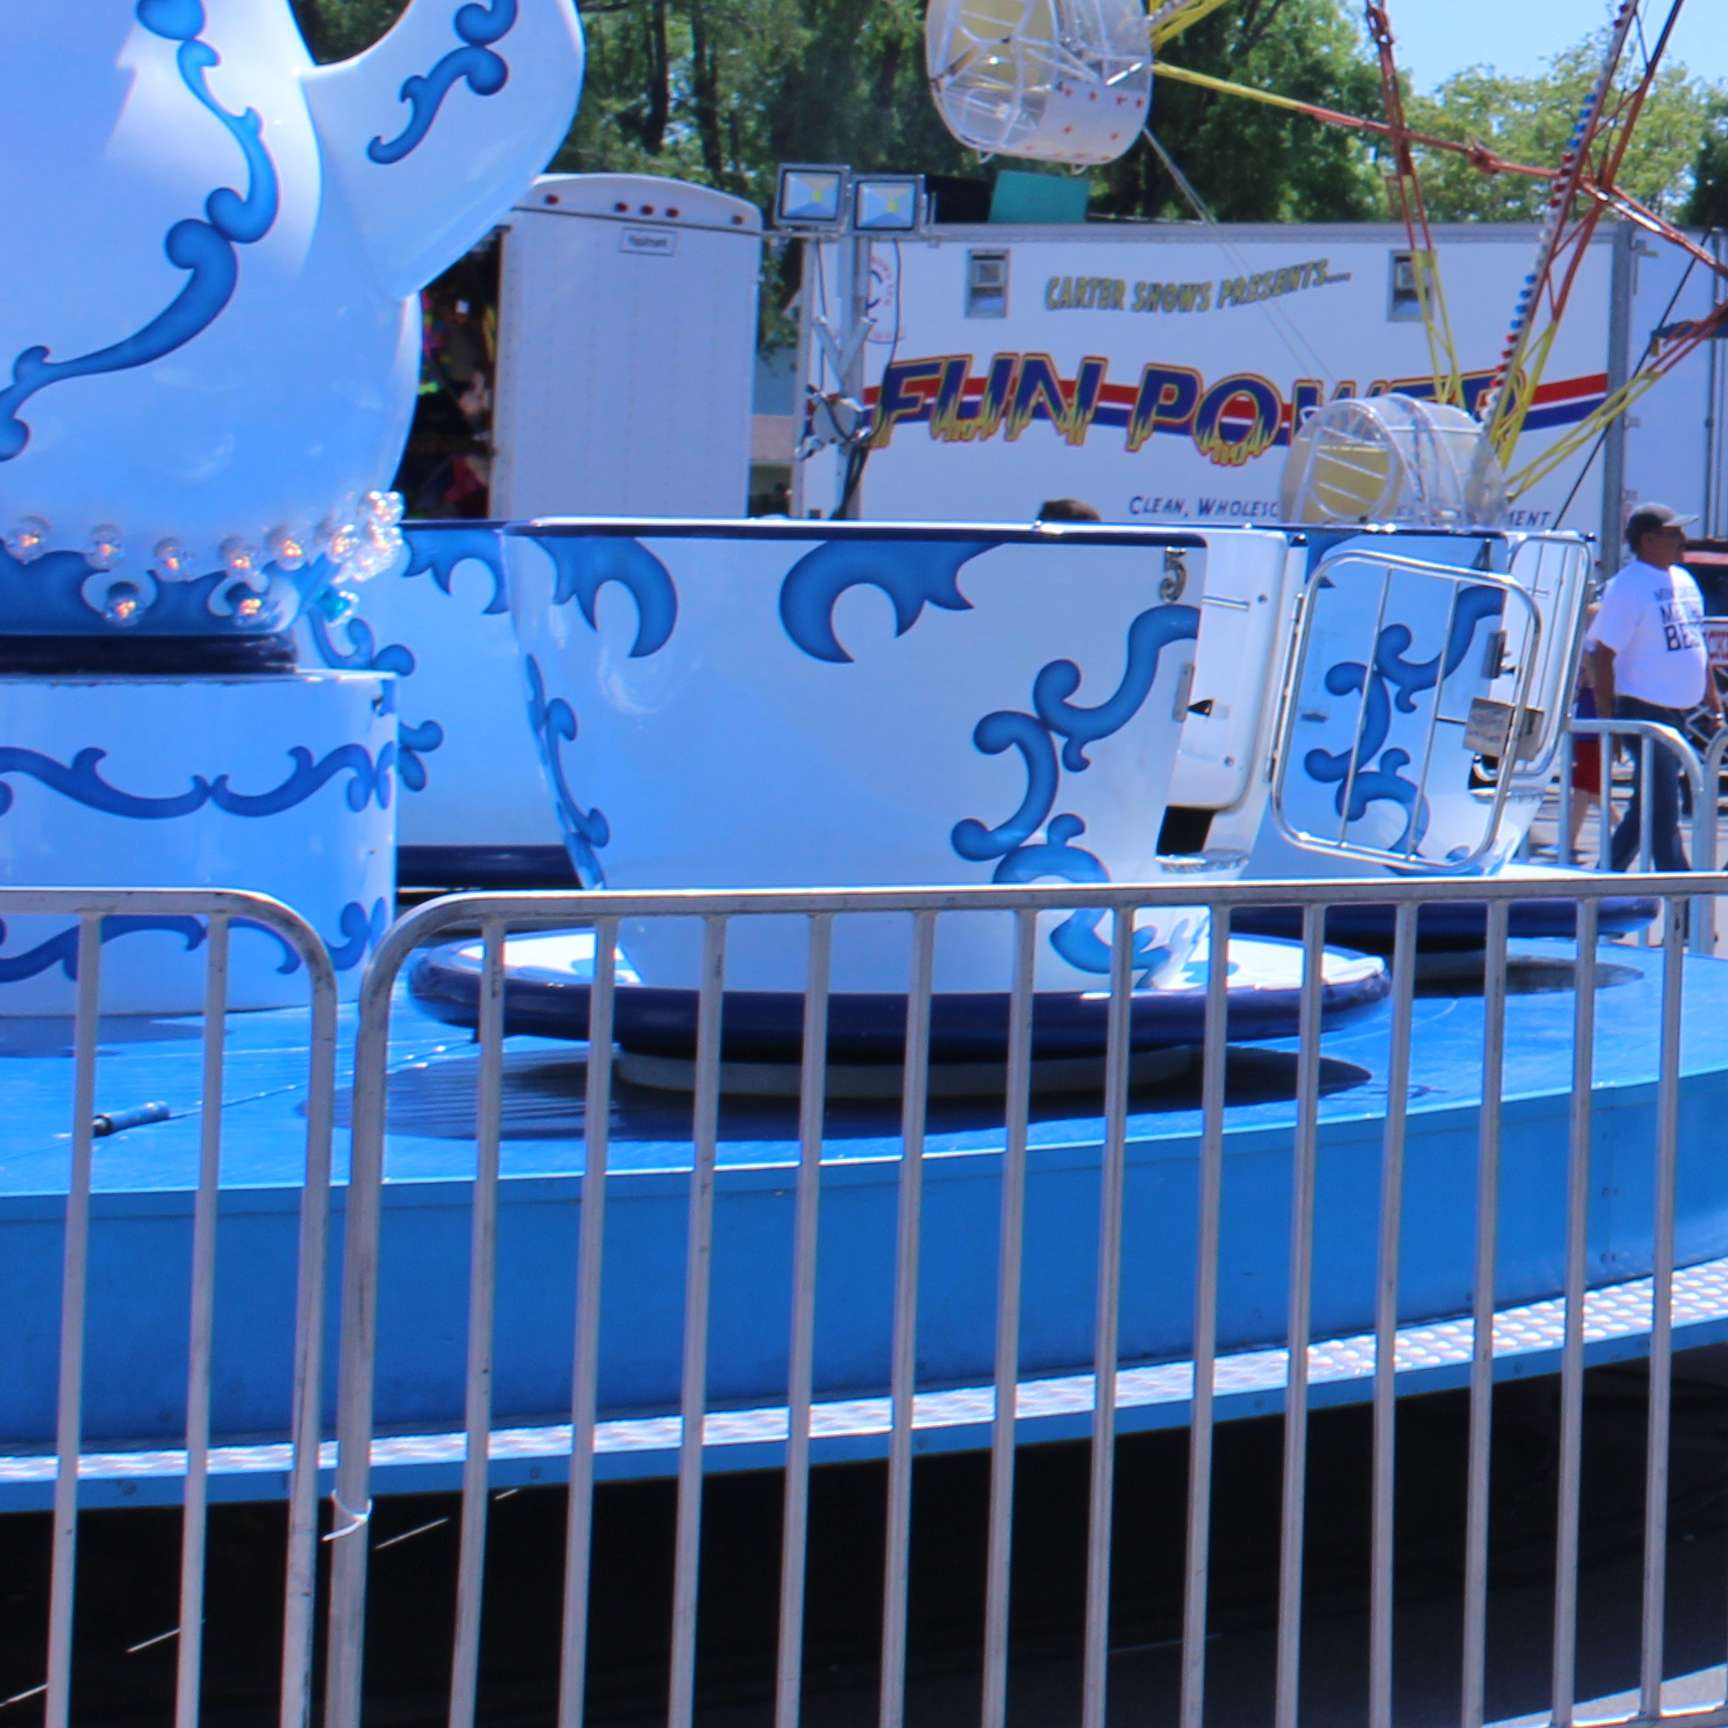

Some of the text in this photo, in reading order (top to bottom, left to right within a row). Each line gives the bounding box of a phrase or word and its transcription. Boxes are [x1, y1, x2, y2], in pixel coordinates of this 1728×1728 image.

[1045, 275, 1125, 311] CARTER
[1130, 281, 1212, 313] SHOWS
[869, 352, 1107, 449] FUN
[1129, 495, 1190, 518] CLEAN,
[1159, 547, 1188, 602] 5
